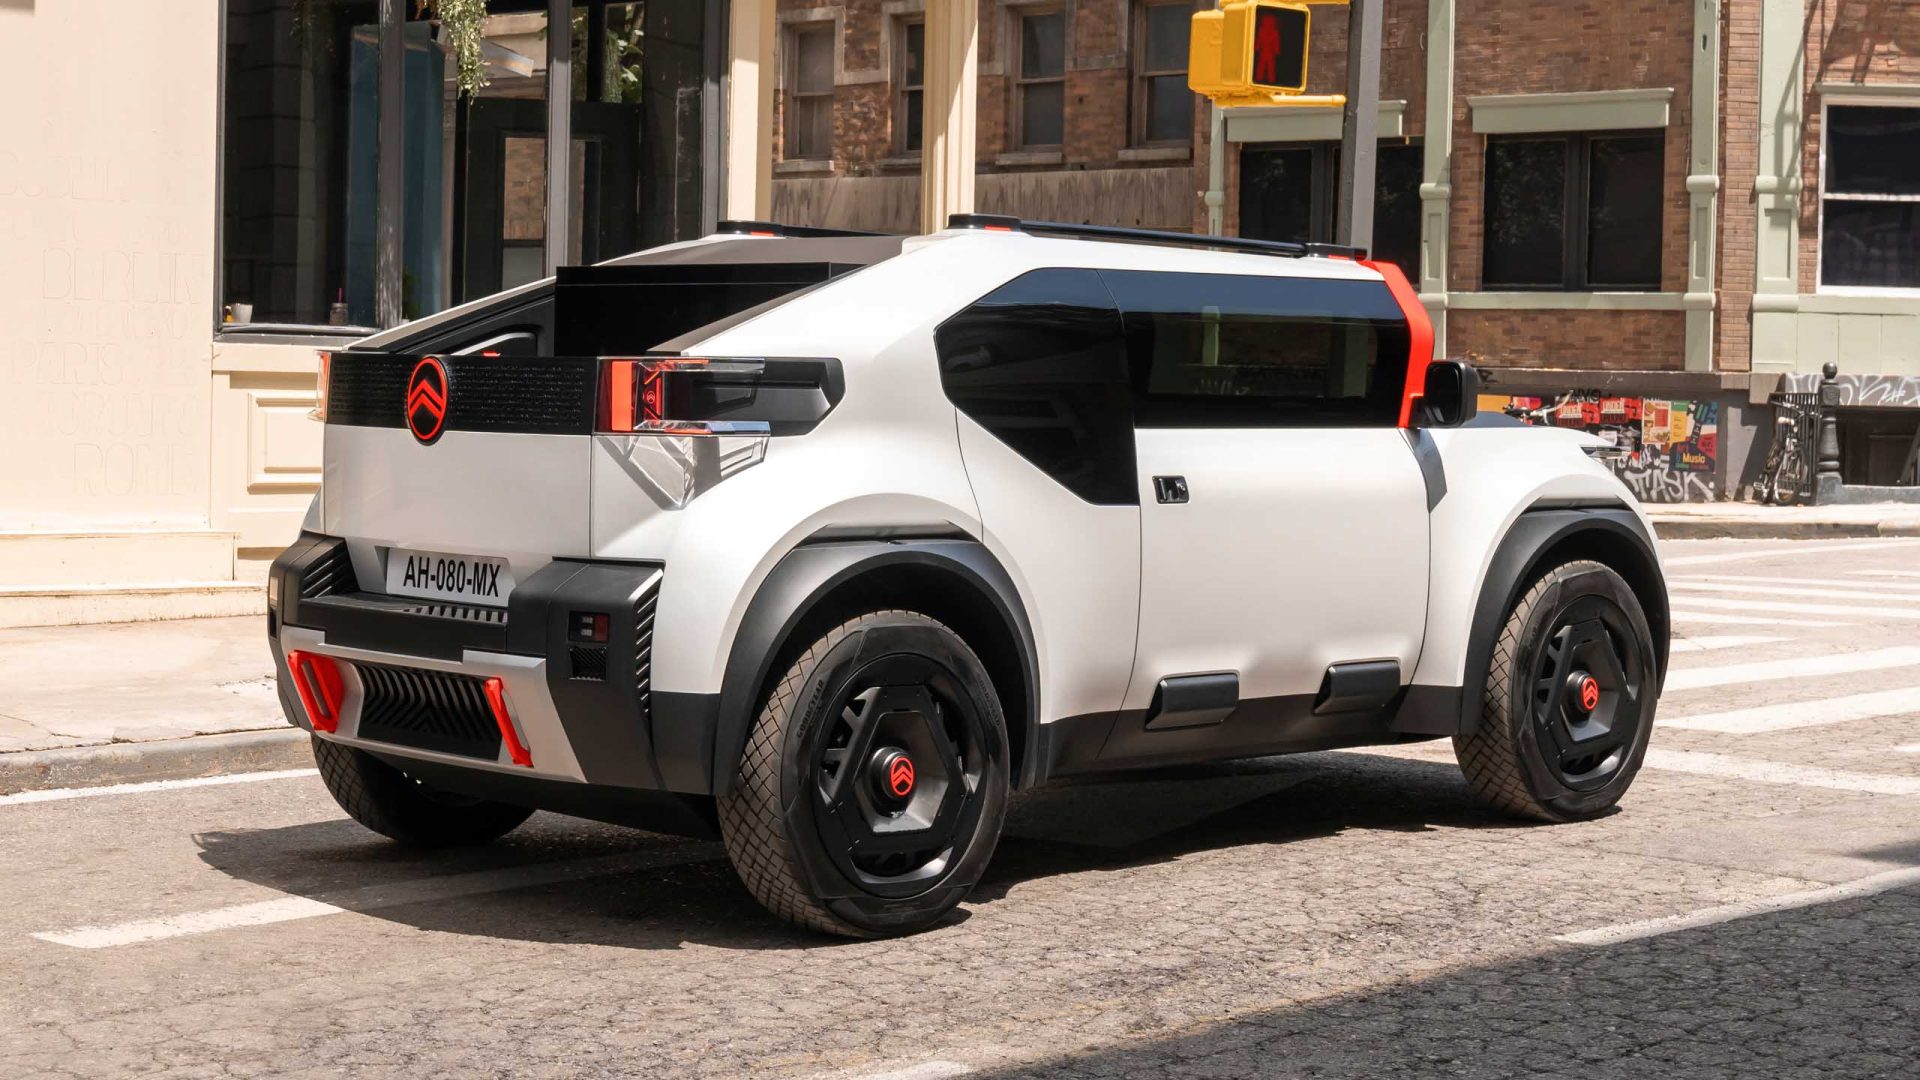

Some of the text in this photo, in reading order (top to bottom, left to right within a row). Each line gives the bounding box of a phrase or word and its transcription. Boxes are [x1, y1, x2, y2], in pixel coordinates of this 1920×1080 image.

[1682, 452, 1705, 464] Music
[402, 555, 501, 598] AH-080-MX
[796, 678, 824, 739] GOODYEAR
